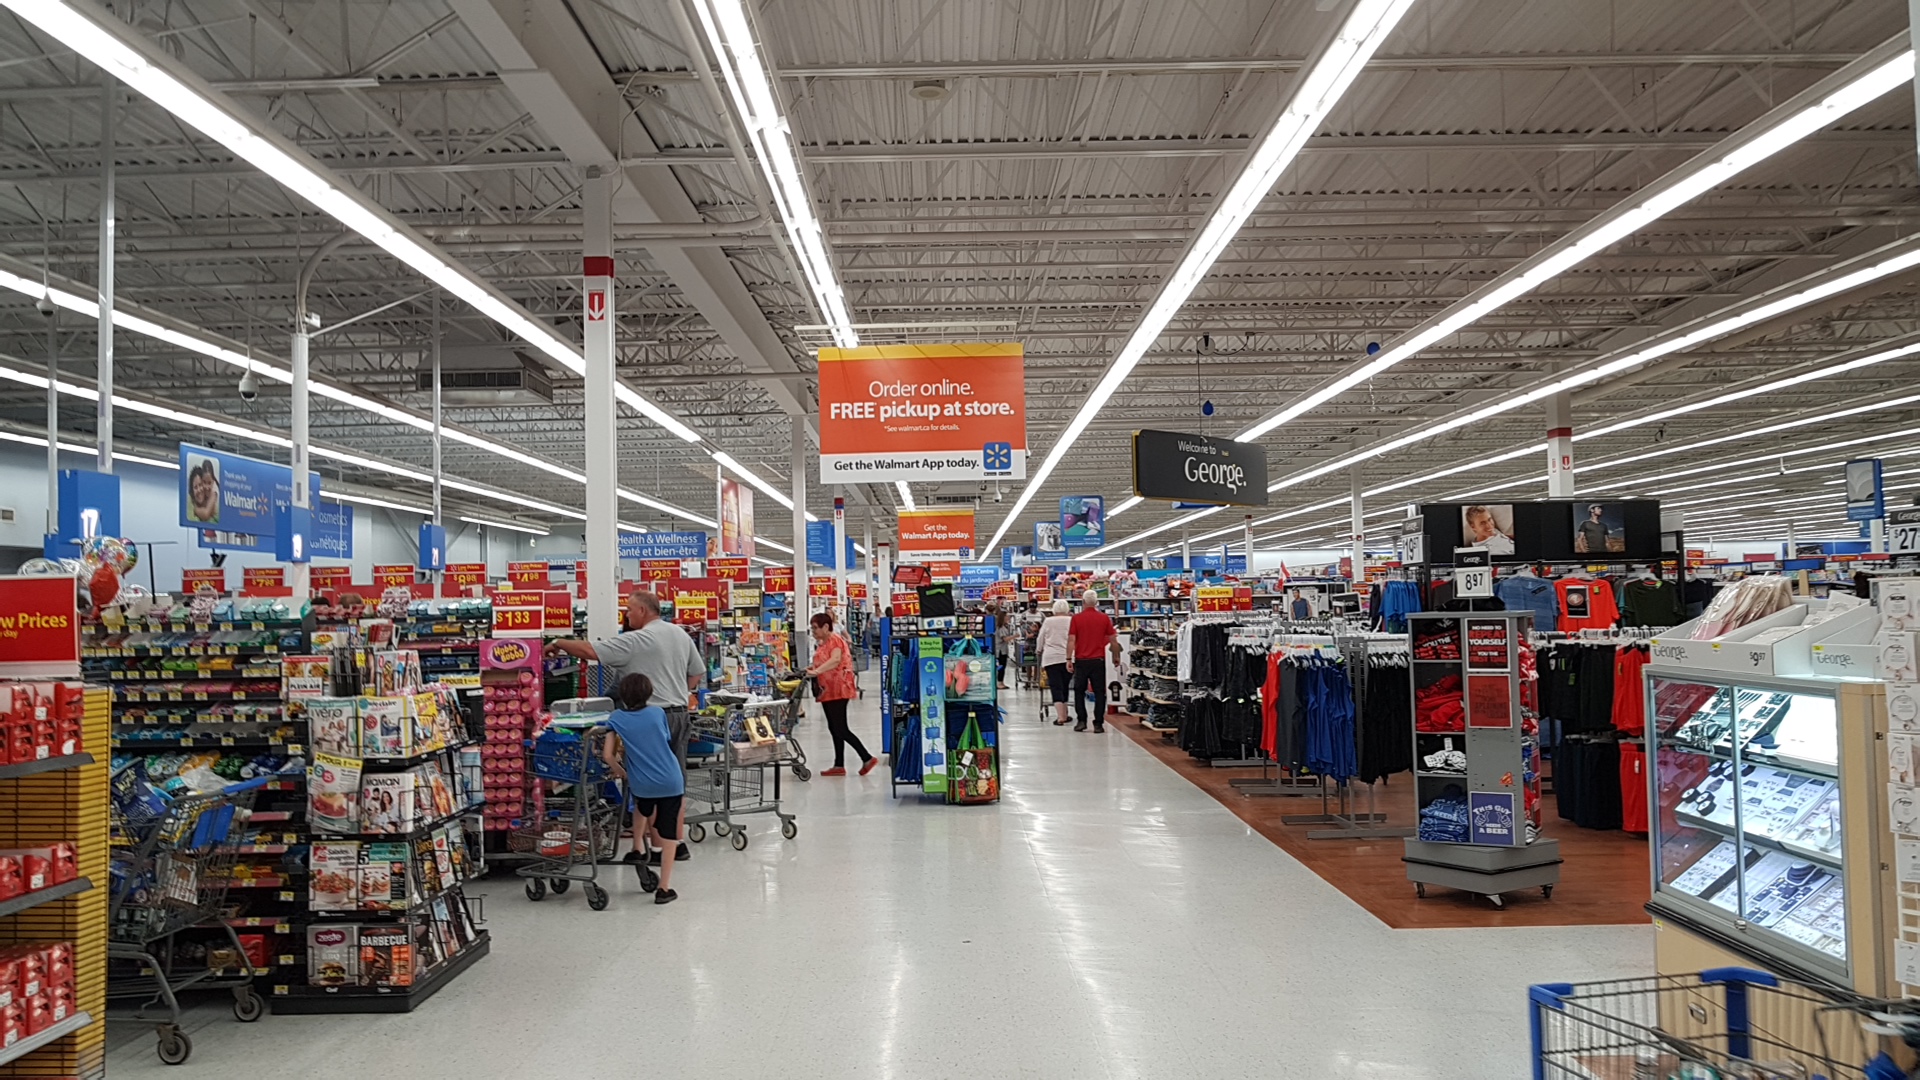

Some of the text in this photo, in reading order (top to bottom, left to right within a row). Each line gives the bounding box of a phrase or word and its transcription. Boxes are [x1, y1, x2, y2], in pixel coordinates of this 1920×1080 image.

[868, 378, 975, 398] Order online.
[880, 400, 941, 422] pickup
[943, 401, 962, 417] at
[964, 401, 1015, 416] store.
[898, 424, 930, 432] walmart.ca
[1177, 440, 1208, 454] Welcome
[1209, 446, 1217, 455] to
[834, 457, 980, 471] Get the Walmart App today.
[1184, 456, 1247, 495] George.
[223, 490, 257, 511] Walmart
[318, 511, 348, 526] osmetics
[618, 534, 698, 545] Health & Wellness
[932, 532, 947, 540] App
[948, 531, 970, 540] today.
[618, 546, 698, 557] Santé et bien-être
[1204, 557, 1219, 565] Toys
[362, 596, 382, 605] rices
[545, 606, 568, 615] Prices
[18, 611, 68, 629] Prices
[3, 629, 18, 639] day
[1468, 630, 1506, 639] REPEAT
[1469, 638, 1507, 646] YOURSELF
[1472, 805, 1512, 815] THIS GUY
[360, 935, 408, 946] BARBECUE
